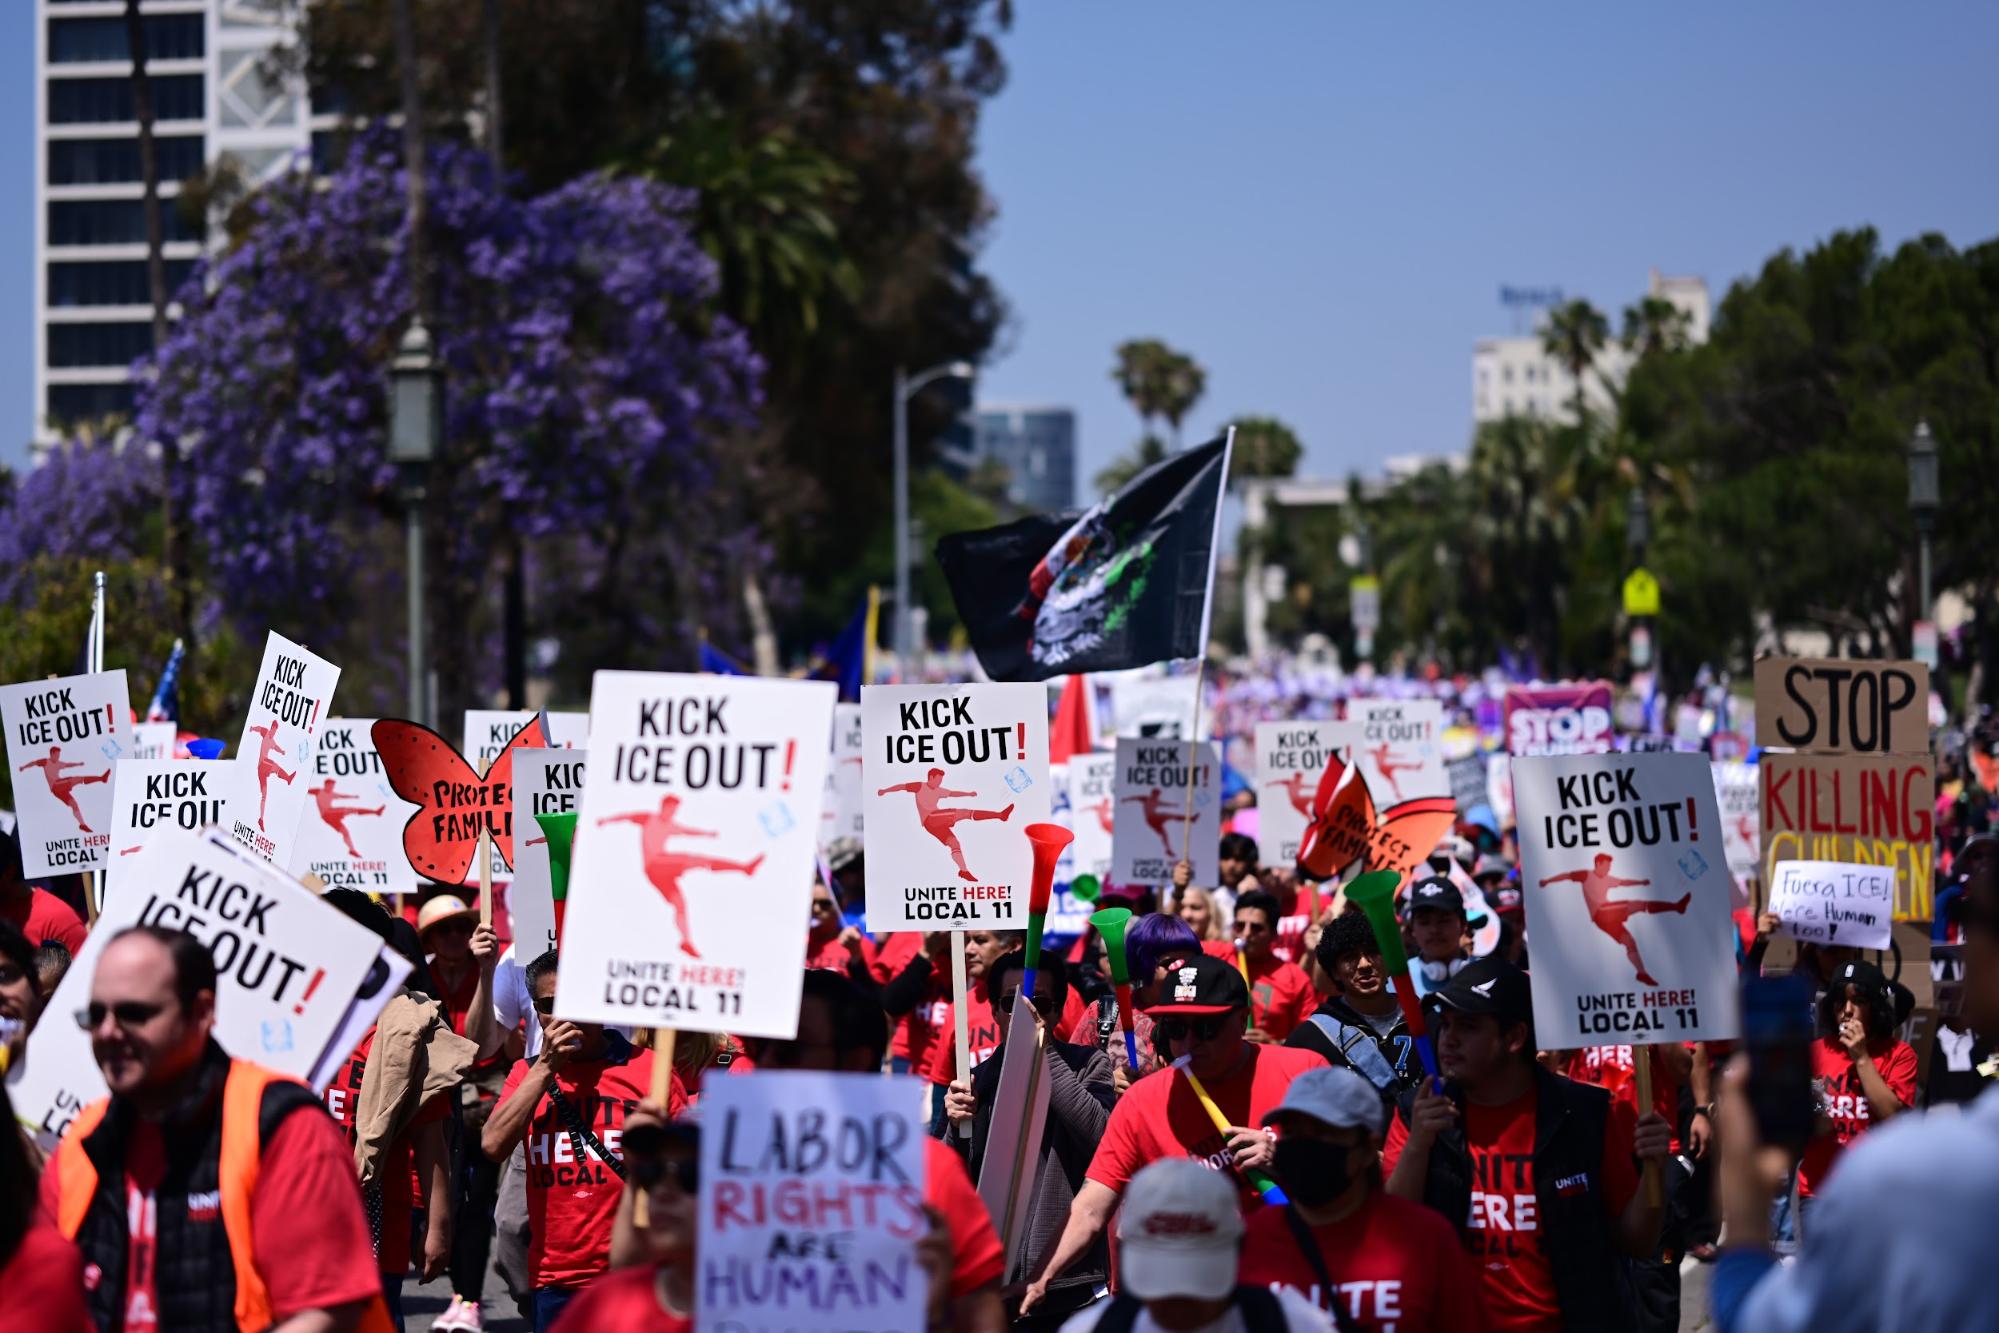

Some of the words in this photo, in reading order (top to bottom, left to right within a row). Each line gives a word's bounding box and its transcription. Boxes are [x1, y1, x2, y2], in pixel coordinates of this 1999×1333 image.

[273, 653, 308, 690] KICK
[24, 687, 76, 720] KICK
[260, 679, 283, 716] ICE
[282, 691, 321, 735] OUT!
[637, 695, 730, 738] KICK
[899, 696, 974, 731] KICK
[1367, 707, 1403, 721] KICK
[1775, 666, 1916, 753] STOP
[19, 716, 53, 747] ICE
[56, 703, 115, 743] OUT!
[490, 723, 523, 743] KIC
[1364, 723, 1384, 740] CE
[1388, 721, 1431, 741] OUT!
[1509, 705, 1610, 741] STOP
[317, 728, 356, 751] ICK
[886, 734, 935, 764] ICE
[941, 722, 1026, 765] OUT!
[1278, 729, 1320, 749] KICK
[613, 744, 674, 784] ICE
[684, 738, 798, 791] OUT!
[1136, 746, 1180, 765] KICK
[1269, 751, 1298, 769] ICE
[146, 771, 208, 800] KICK
[544, 762, 586, 790] KIC
[1127, 766, 1157, 786] ICE
[1556, 766, 1641, 811] KICK
[177, 799, 226, 830] OU
[1764, 764, 1933, 844] KILLING
[234, 819, 255, 843] UNITE
[254, 833, 277, 857] HERE!
[1544, 812, 1602, 850] ICE
[1606, 796, 1700, 849] OUT!
[45, 837, 81, 852] UNITE
[47, 848, 99, 867] LOCAL
[311, 862, 349, 873] UNITE
[352, 860, 388, 873] HERE!
[374, 872, 388, 886] 11
[1132, 867, 1173, 880] LOCA
[177, 863, 279, 937] KICK
[904, 887, 957, 901] UNITE
[963, 885, 1012, 900] HERE!
[1782, 869, 1836, 899] Fuera
[1841, 873, 1889, 902] ICE!
[904, 902, 981, 920] LOCAL
[992, 901, 1013, 919] 11
[1825, 901, 1877, 927] Human
[606, 958, 672, 983] UNITE
[679, 963, 746, 987] HERE!
[604, 983, 700, 1012] LOCAL
[716, 991, 742, 1016] 11
[1577, 991, 1638, 1012] UNITE
[1643, 987, 1696, 1009] HERE!
[1578, 1009, 1665, 1035] LOCAL
[1675, 1006, 1699, 1031] 11
[1584, 1045, 1634, 1068] HER
[718, 1106, 914, 1184] LABOR
[530, 1165, 608, 1189] LOCAL
[1472, 1154, 1535, 1189] NIT
[1554, 1172, 1588, 1190] UNITE
[712, 1179, 927, 1240] RIGHTS
[1466, 1191, 1538, 1231] ERE
[766, 1230, 856, 1263] ARE
[703, 1257, 909, 1314] HUMAN
